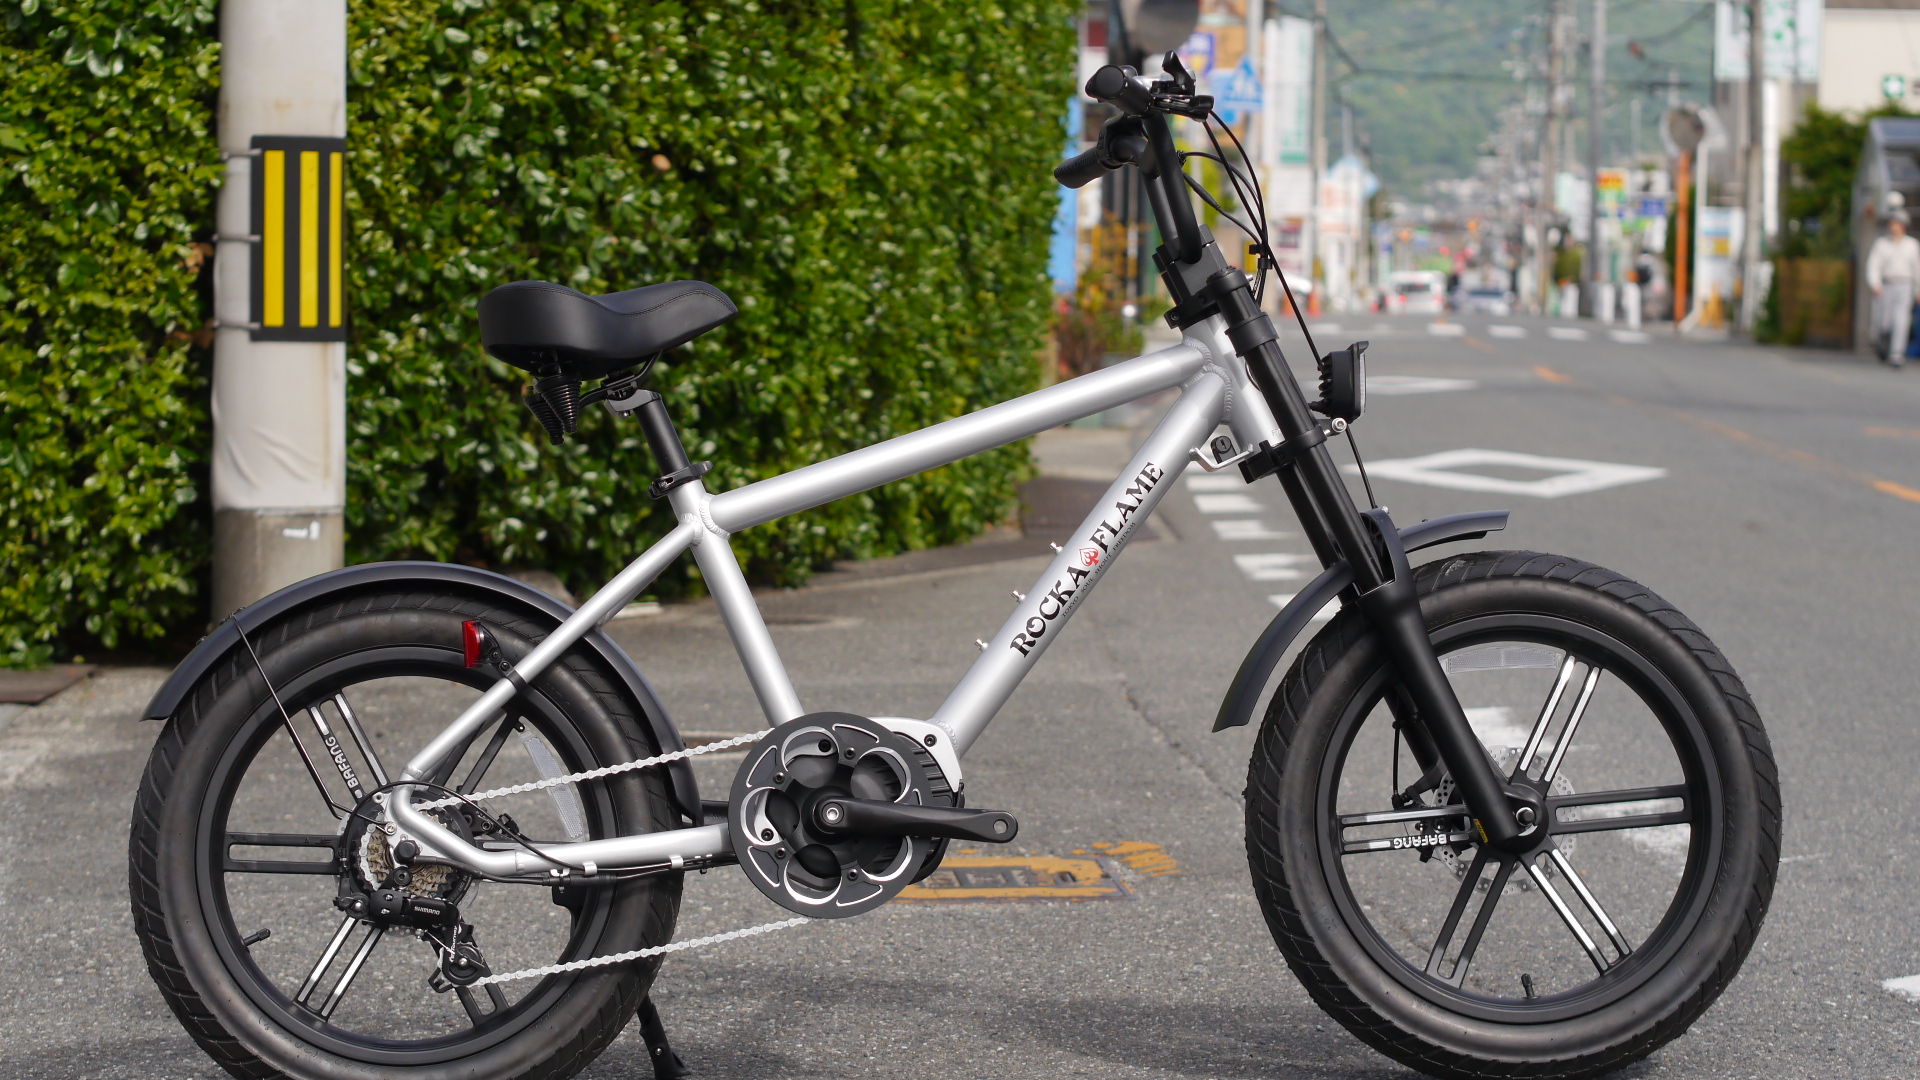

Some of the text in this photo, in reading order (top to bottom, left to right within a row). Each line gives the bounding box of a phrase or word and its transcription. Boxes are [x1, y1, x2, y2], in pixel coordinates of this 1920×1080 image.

[1010, 462, 1164, 658] ROCKA FLAME
[1061, 596, 1079, 618] TOKYO
[1094, 553, 1112, 576] SHOUT
[325, 736, 359, 788] BAFANG
[1393, 834, 1448, 849] BAFANG
[414, 905, 441, 915] SHIMANO
